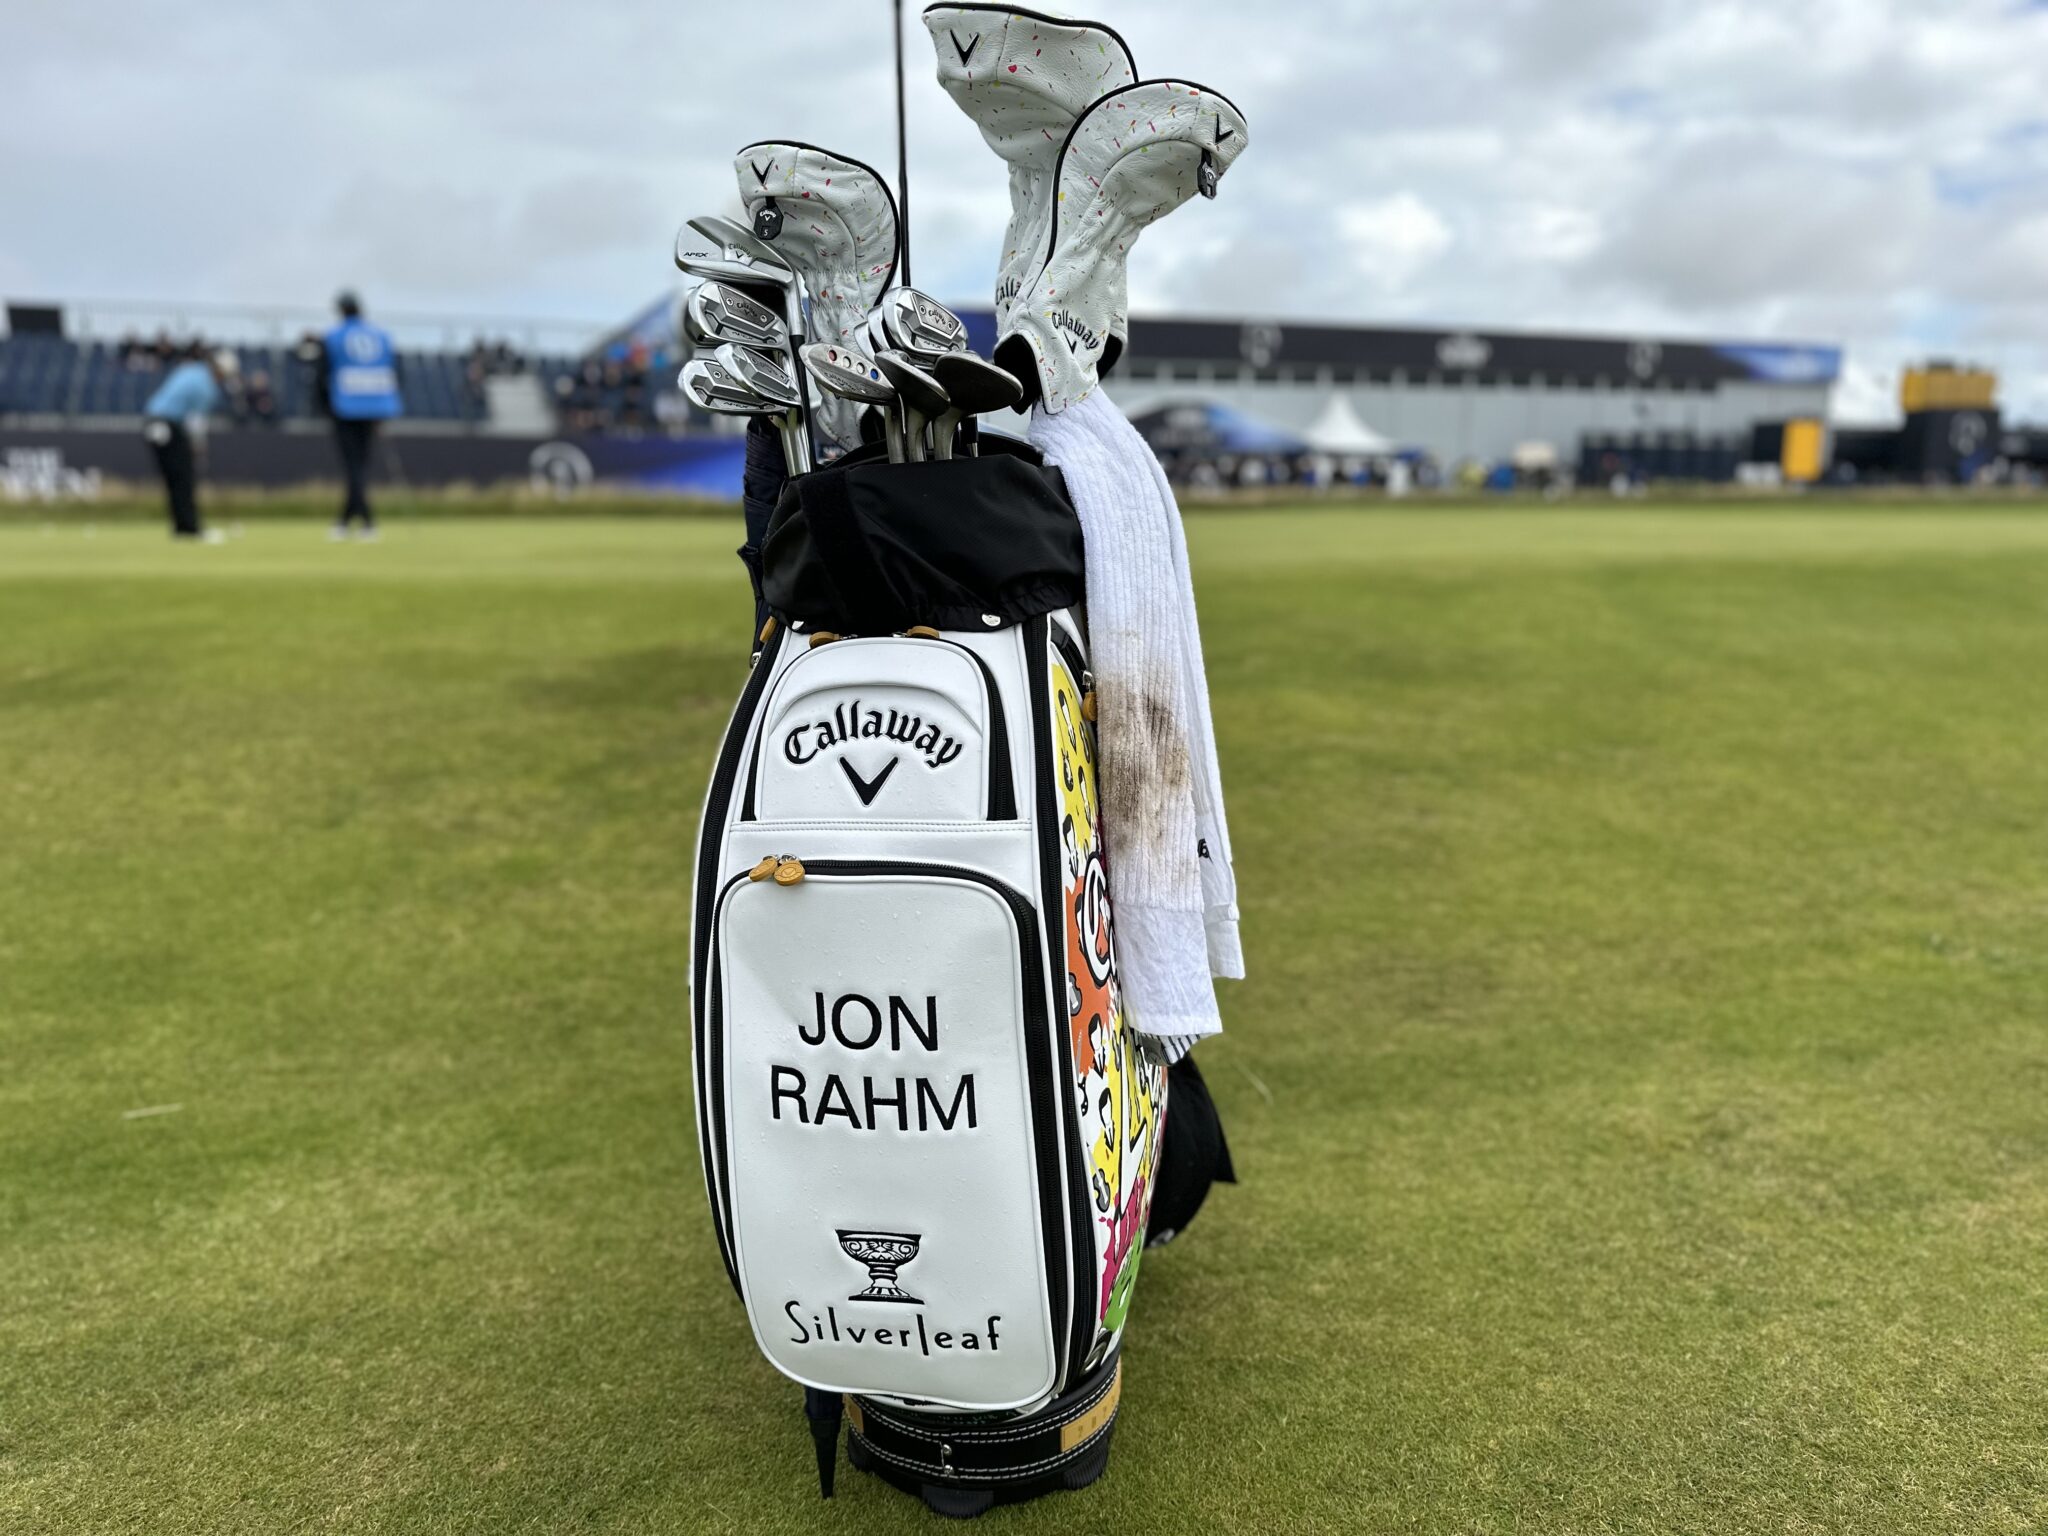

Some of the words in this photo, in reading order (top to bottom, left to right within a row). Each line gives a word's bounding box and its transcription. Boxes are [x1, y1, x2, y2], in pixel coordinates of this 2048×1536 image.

[995, 276, 1022, 306] Calla
[1052, 309, 1099, 350] Callaway
[784, 700, 963, 769] Callaway
[798, 991, 938, 1051] JON
[771, 1064, 977, 1131] RAHM
[784, 1300, 1001, 1356] Silverleaf
